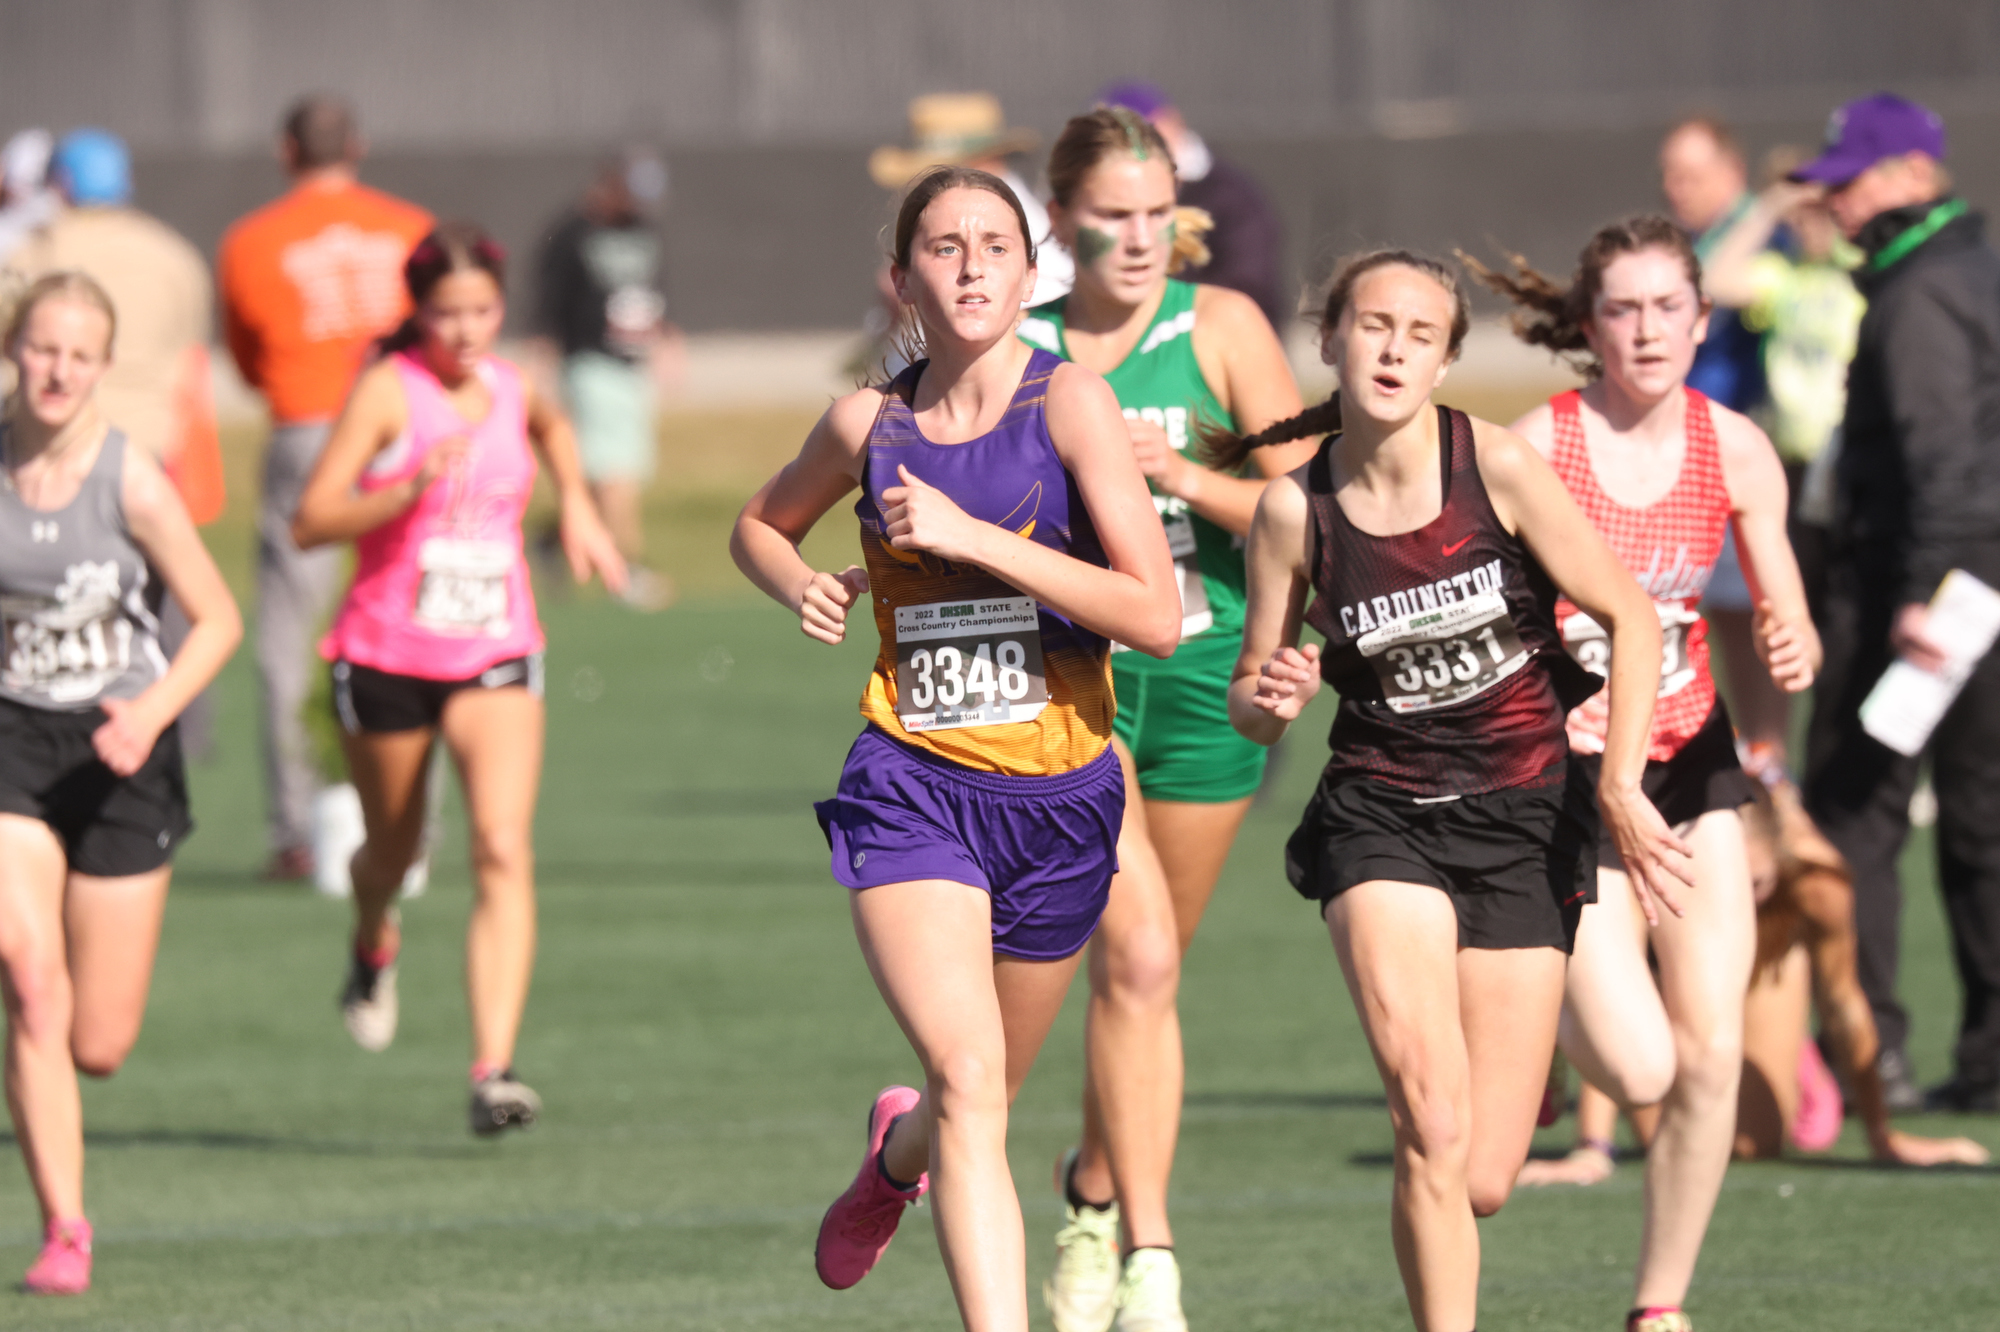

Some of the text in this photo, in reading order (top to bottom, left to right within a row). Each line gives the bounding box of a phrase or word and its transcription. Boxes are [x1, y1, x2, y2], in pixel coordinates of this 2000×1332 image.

[914, 603, 1012, 620] 2022 OHSAA STATE
[1340, 558, 1504, 635] CARDINGTON
[898, 614, 1035, 633] Cross Country Championships
[1381, 625, 1403, 637] 2022
[910, 640, 1030, 709] 3348
[1386, 626, 1506, 692] 3331
